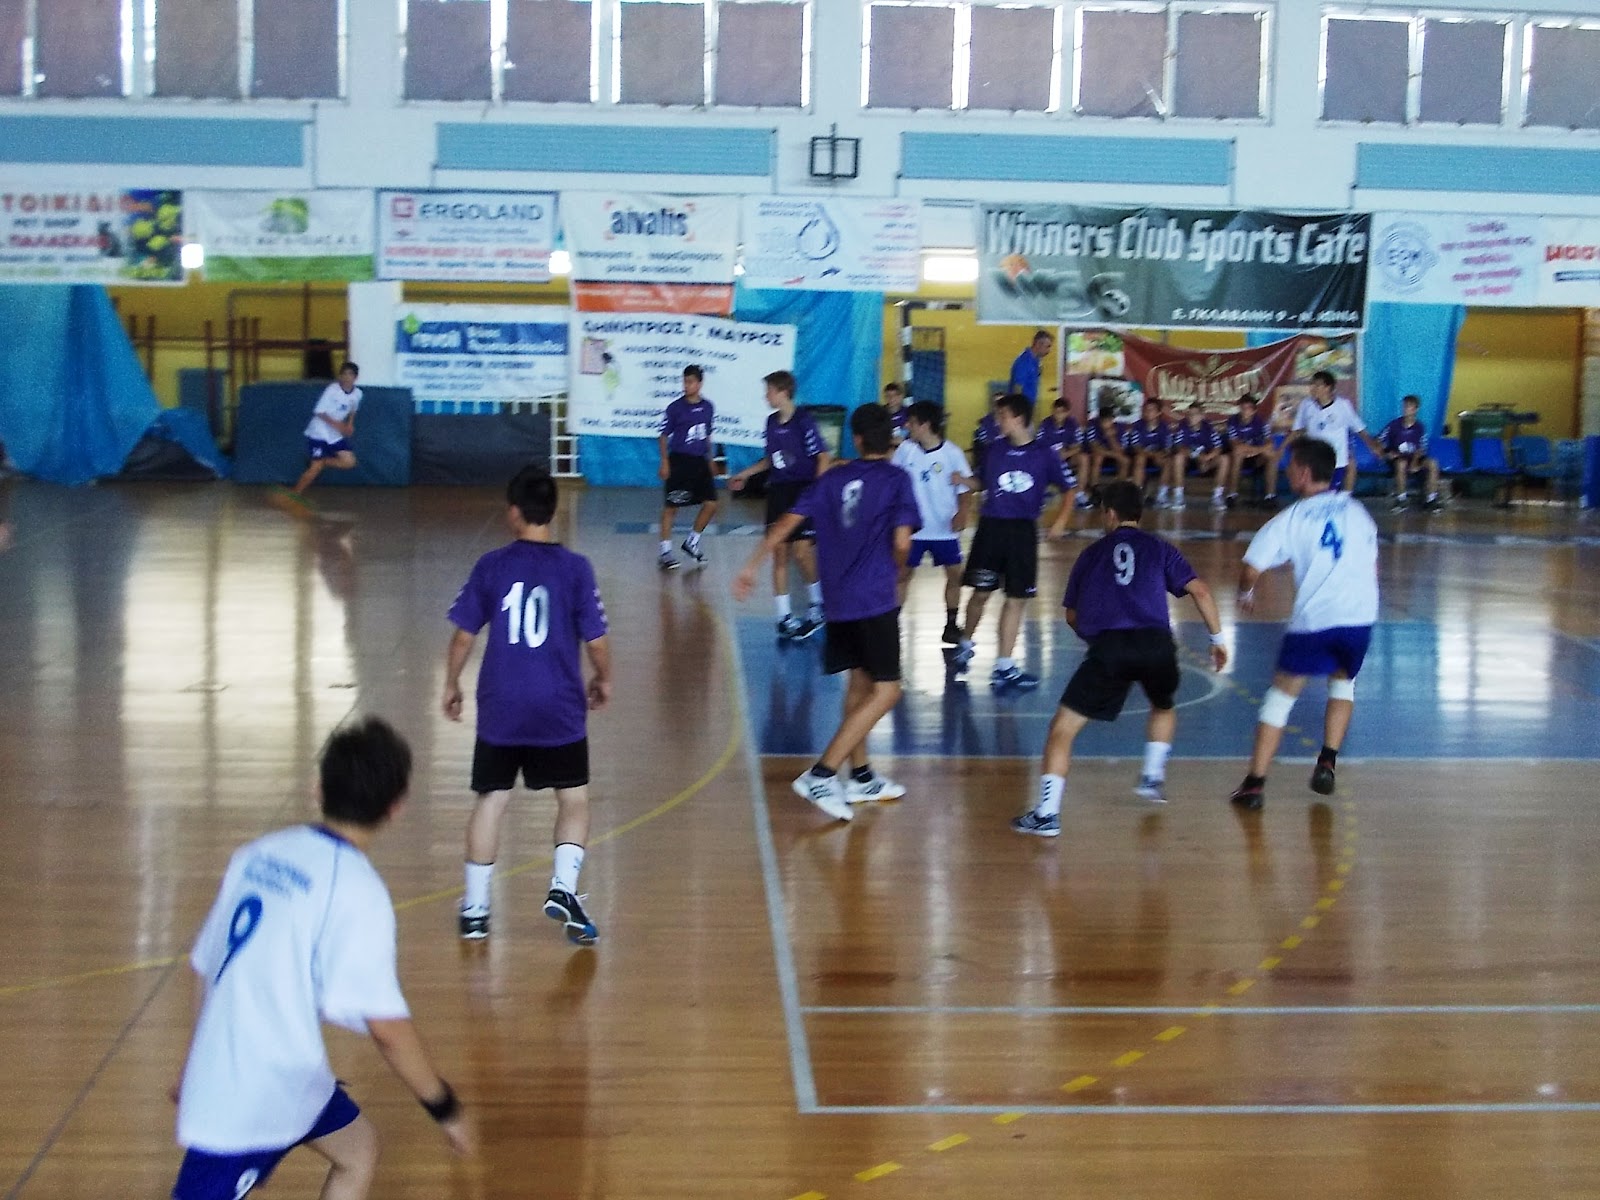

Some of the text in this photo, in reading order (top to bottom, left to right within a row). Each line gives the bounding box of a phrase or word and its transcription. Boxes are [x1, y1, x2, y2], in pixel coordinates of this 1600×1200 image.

[419, 203, 545, 221] ERGOLAND
[984, 210, 1114, 258] Winners
[1117, 216, 1184, 261] Club
[1187, 218, 1295, 273] Sports
[1320, 520, 1343, 560] 4
[1112, 543, 1136, 586] 9
[501, 581, 549, 649] 10
